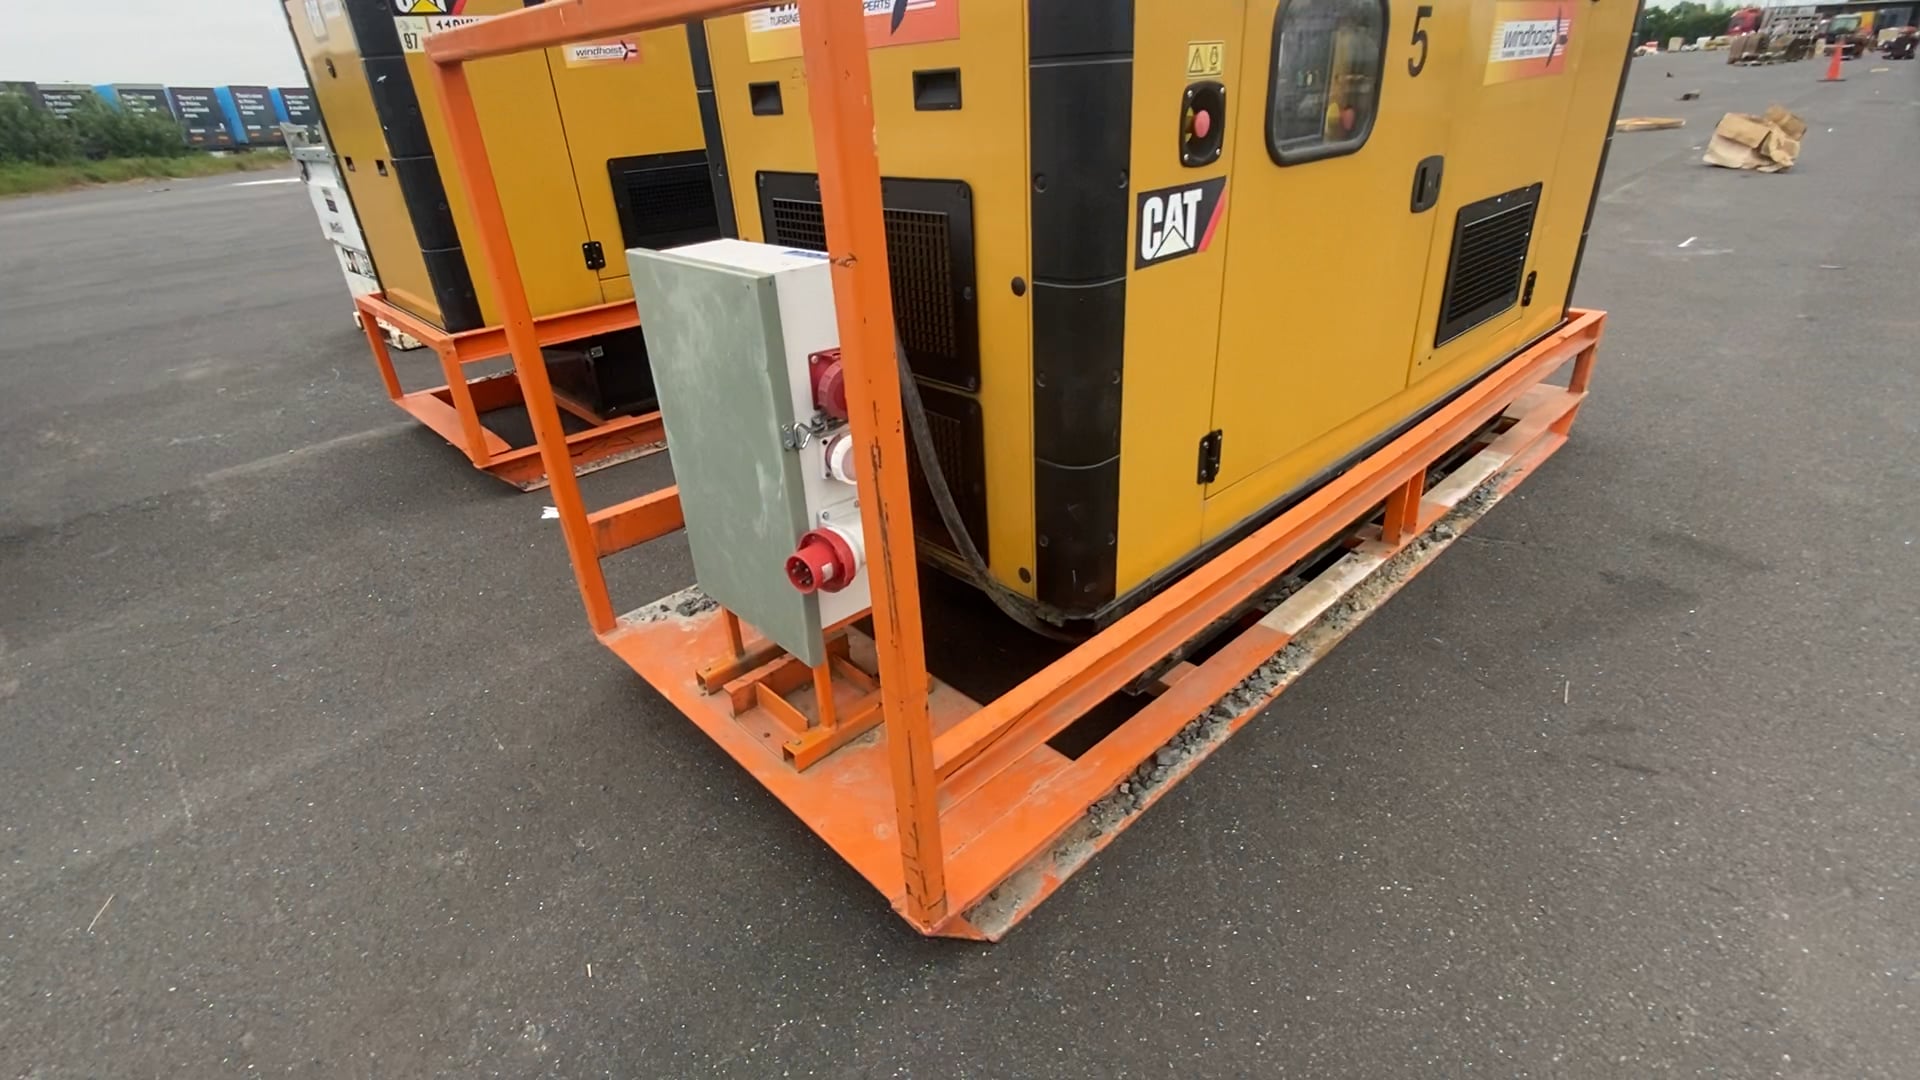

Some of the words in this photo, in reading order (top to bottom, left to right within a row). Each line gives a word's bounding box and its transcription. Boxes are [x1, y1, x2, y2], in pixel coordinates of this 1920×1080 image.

[575, 46, 624, 57] windhoist
[1407, 5, 1433, 78] 5
[1502, 23, 1556, 49] windhoist
[1141, 187, 1203, 261] CAT
